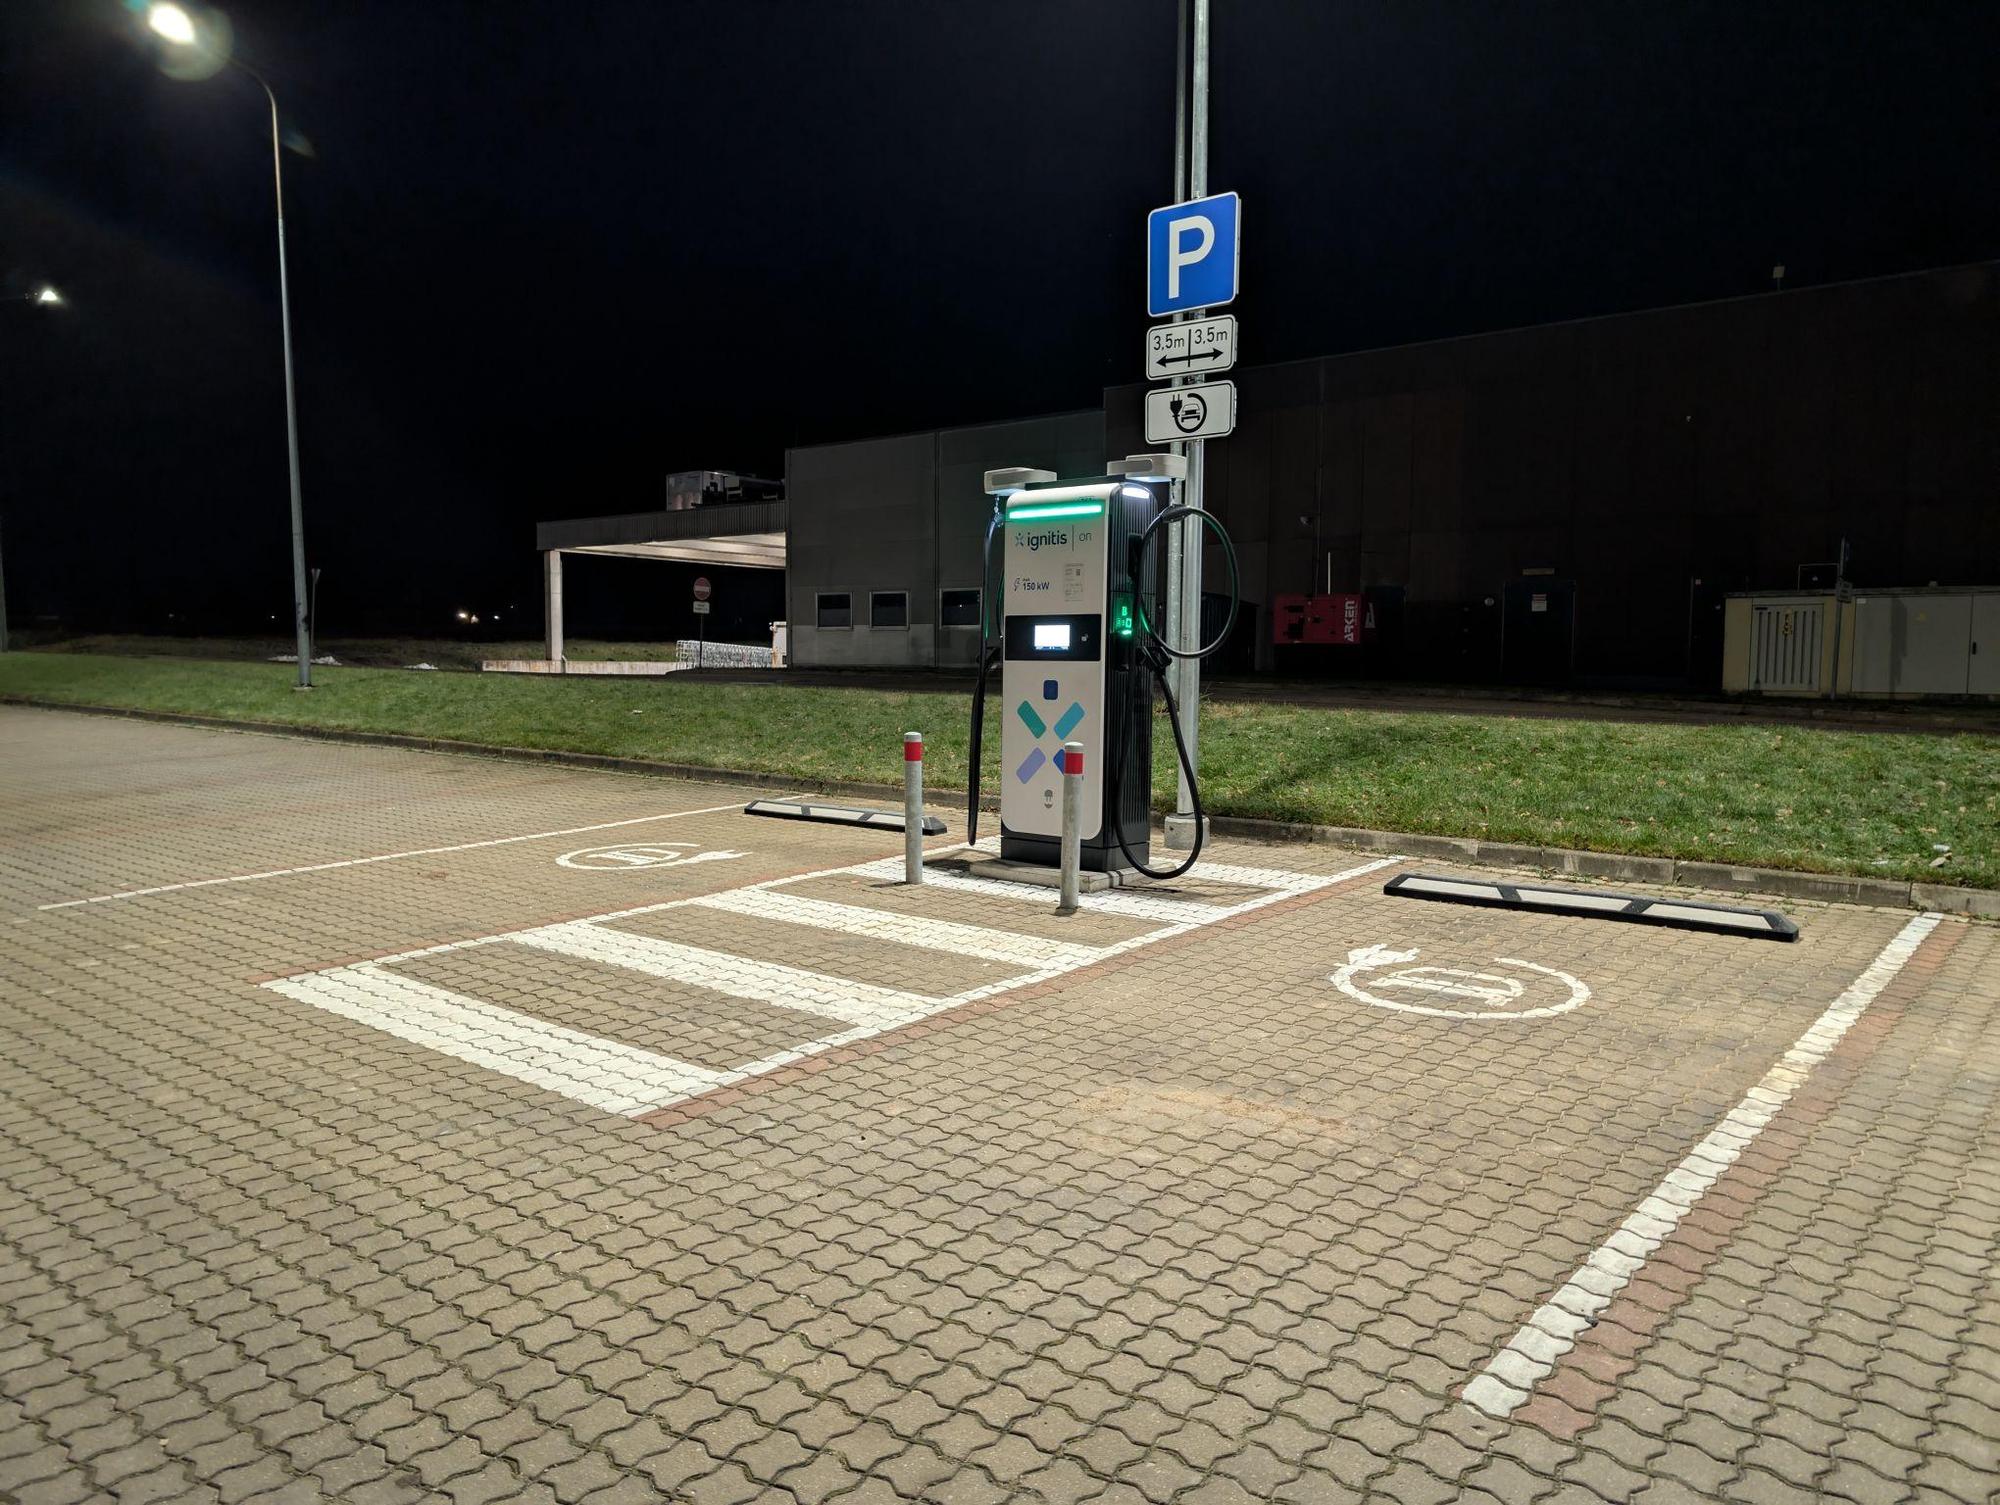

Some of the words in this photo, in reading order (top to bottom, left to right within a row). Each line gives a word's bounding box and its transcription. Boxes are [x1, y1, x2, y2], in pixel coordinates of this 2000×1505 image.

[1168, 215, 1215, 300] P
[1027, 530, 1067, 551] ignitis
[1079, 533, 1092, 542] on
[1023, 582, 1035, 591] 150
[1036, 581, 1050, 591] kW
